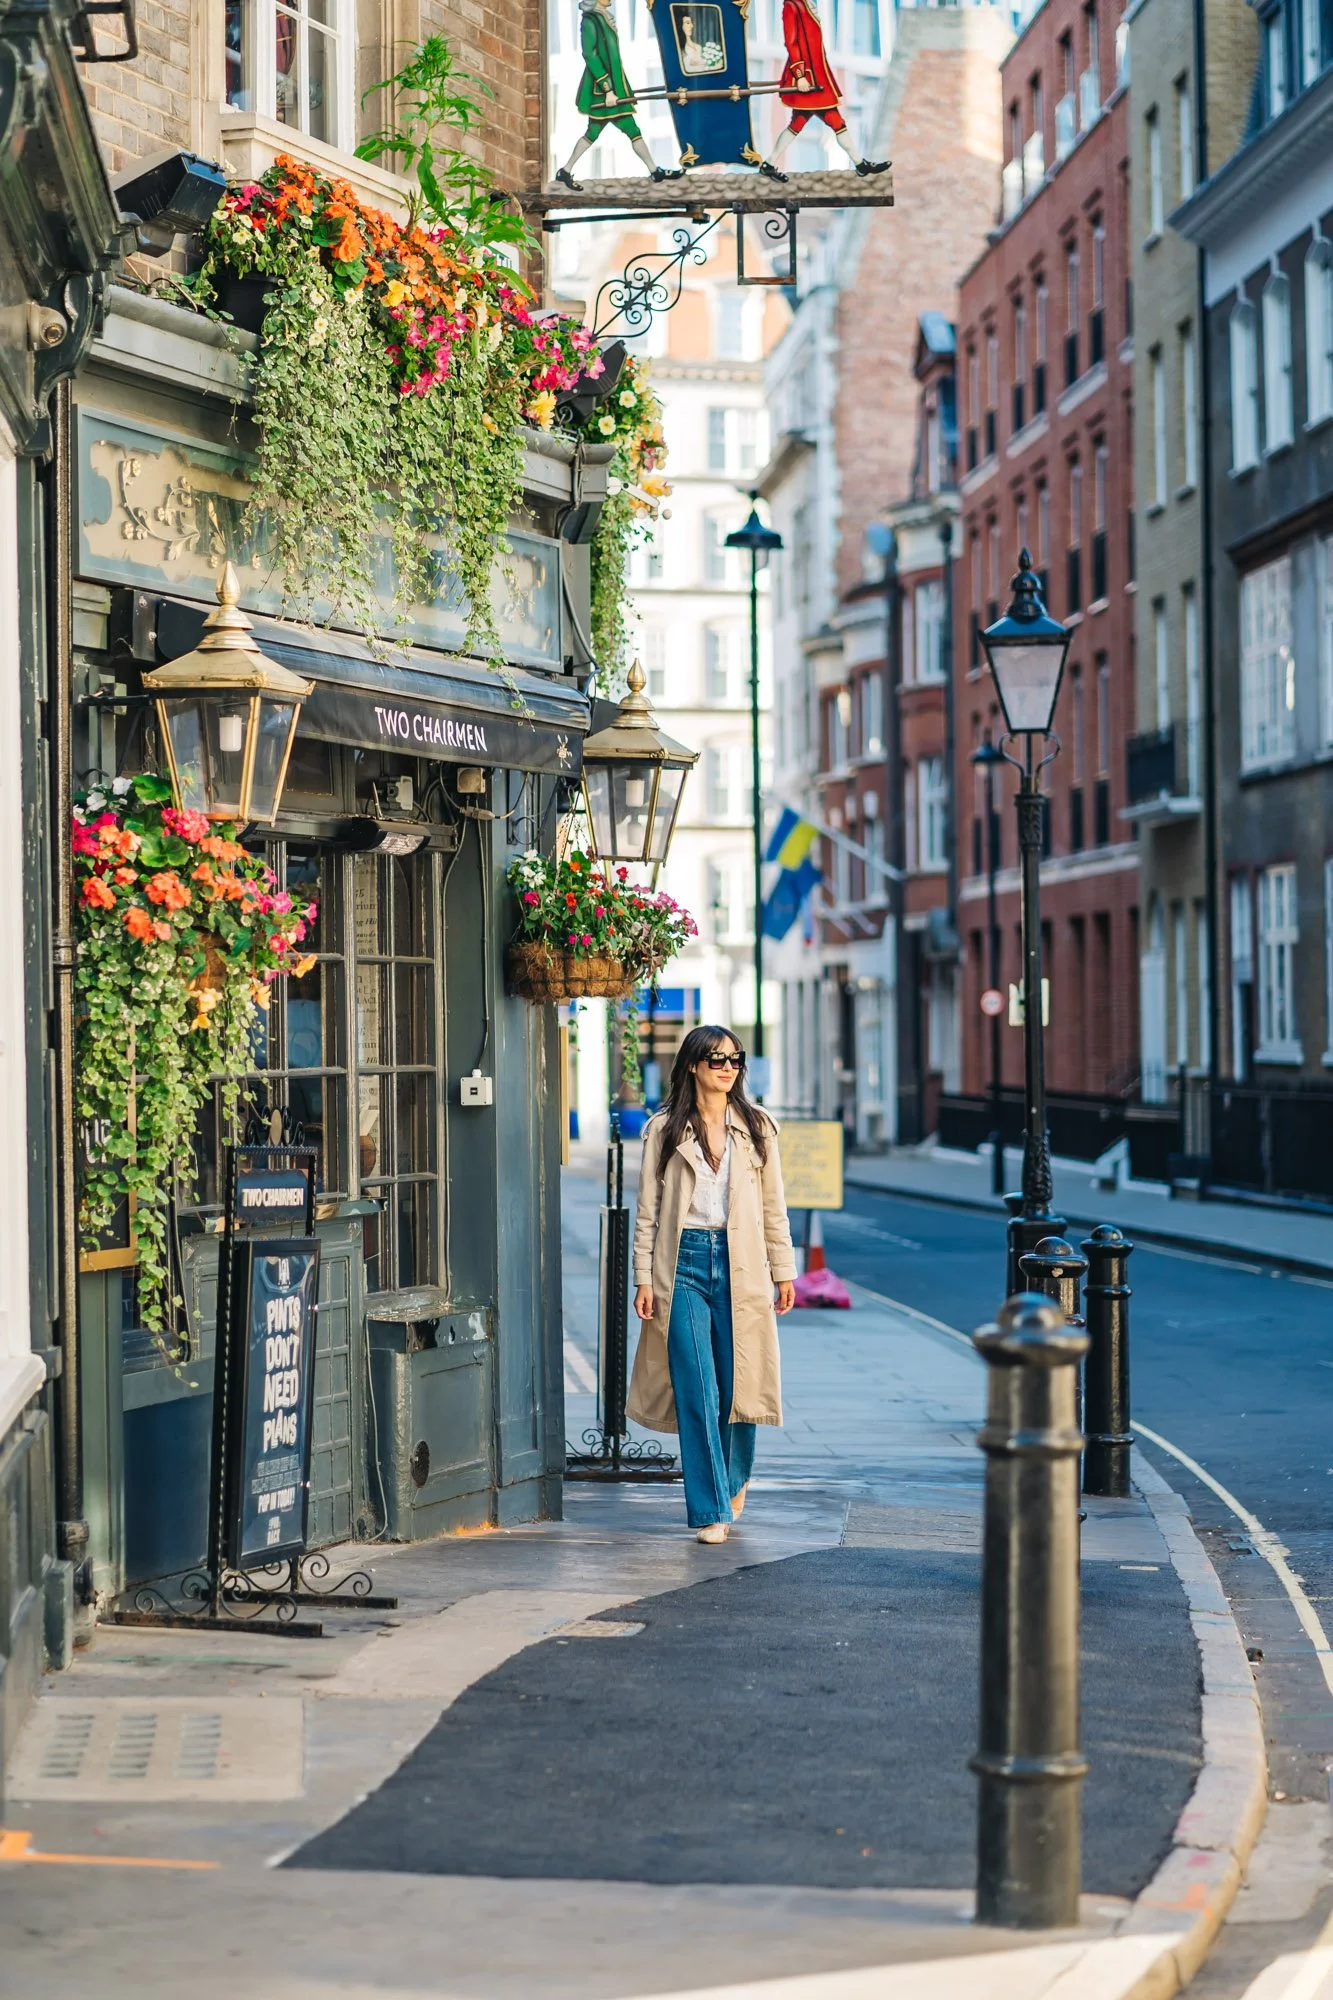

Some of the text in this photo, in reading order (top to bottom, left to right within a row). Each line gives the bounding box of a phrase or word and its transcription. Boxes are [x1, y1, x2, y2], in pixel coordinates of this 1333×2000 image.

[374, 706, 488, 752] TWO CHAIRMEN
[241, 1188, 304, 1207] TWO CHAIRMEN
[266, 1296, 301, 1335] PINTS
[265, 1333, 300, 1374] DON'T
[263, 1369, 299, 1413] NEED
[263, 1408, 298, 1454] PLANS
